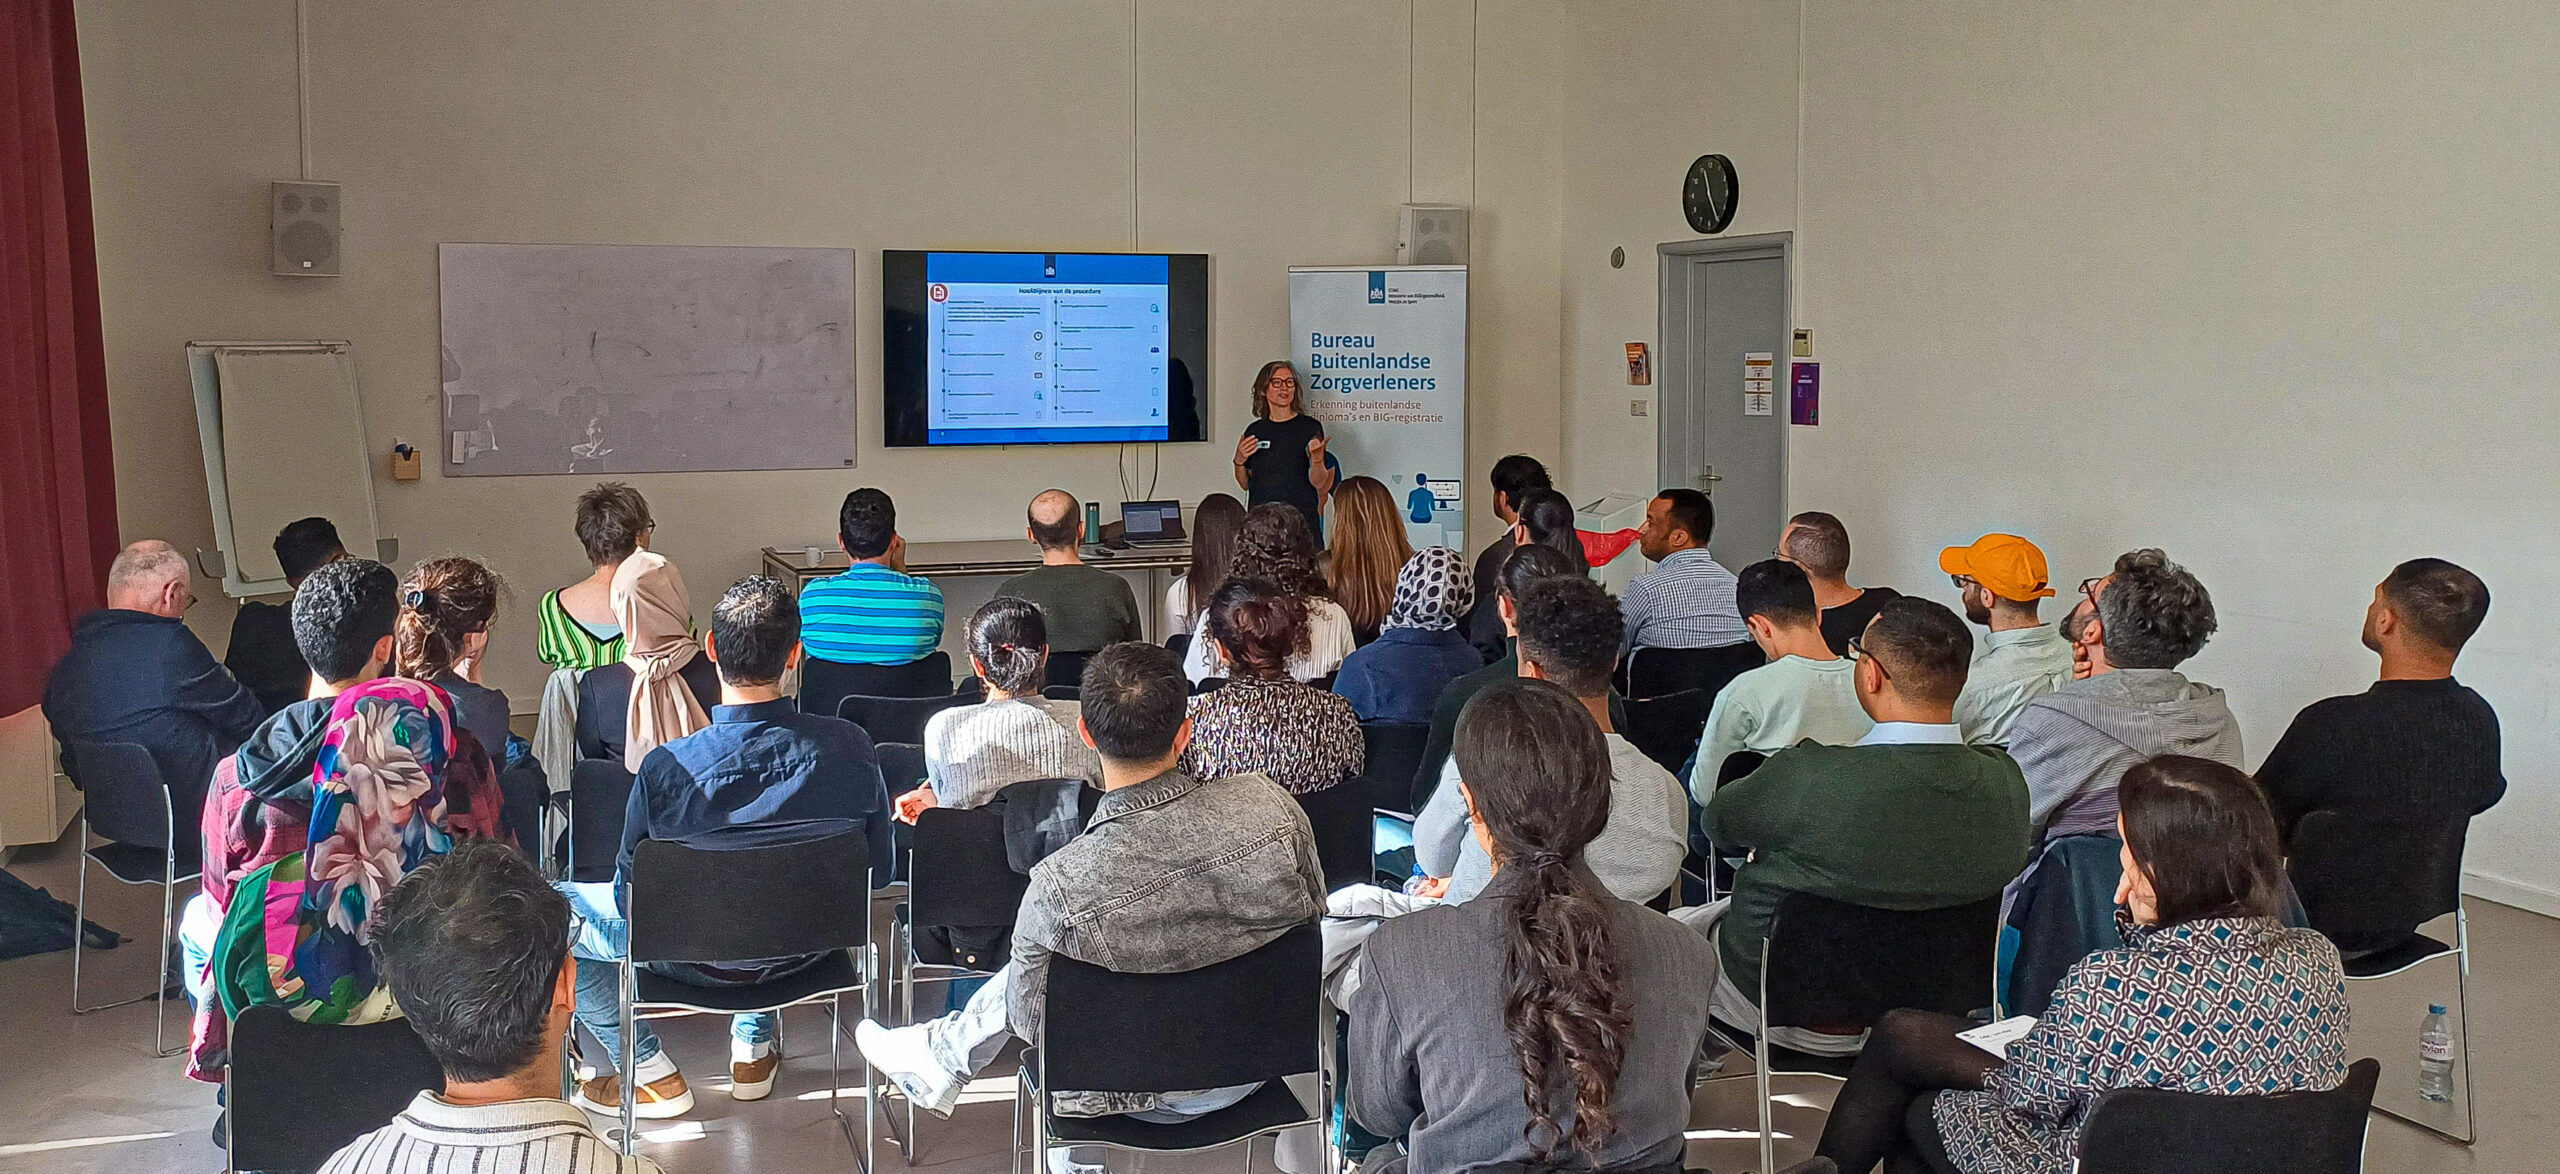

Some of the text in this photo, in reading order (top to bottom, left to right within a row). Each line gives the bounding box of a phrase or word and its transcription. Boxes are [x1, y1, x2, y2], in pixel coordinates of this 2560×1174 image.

[1311, 332, 1375, 348] Bureau
[1311, 352, 1431, 369] Buitenlandse
[1310, 373, 1436, 394] Zorgverleners
[1310, 399, 1421, 411] Erkenning buitenlandse
[1358, 413, 1371, 422] en
[1373, 412, 1443, 424] BIG-registratie
[2421, 1044, 2446, 1055] evian
